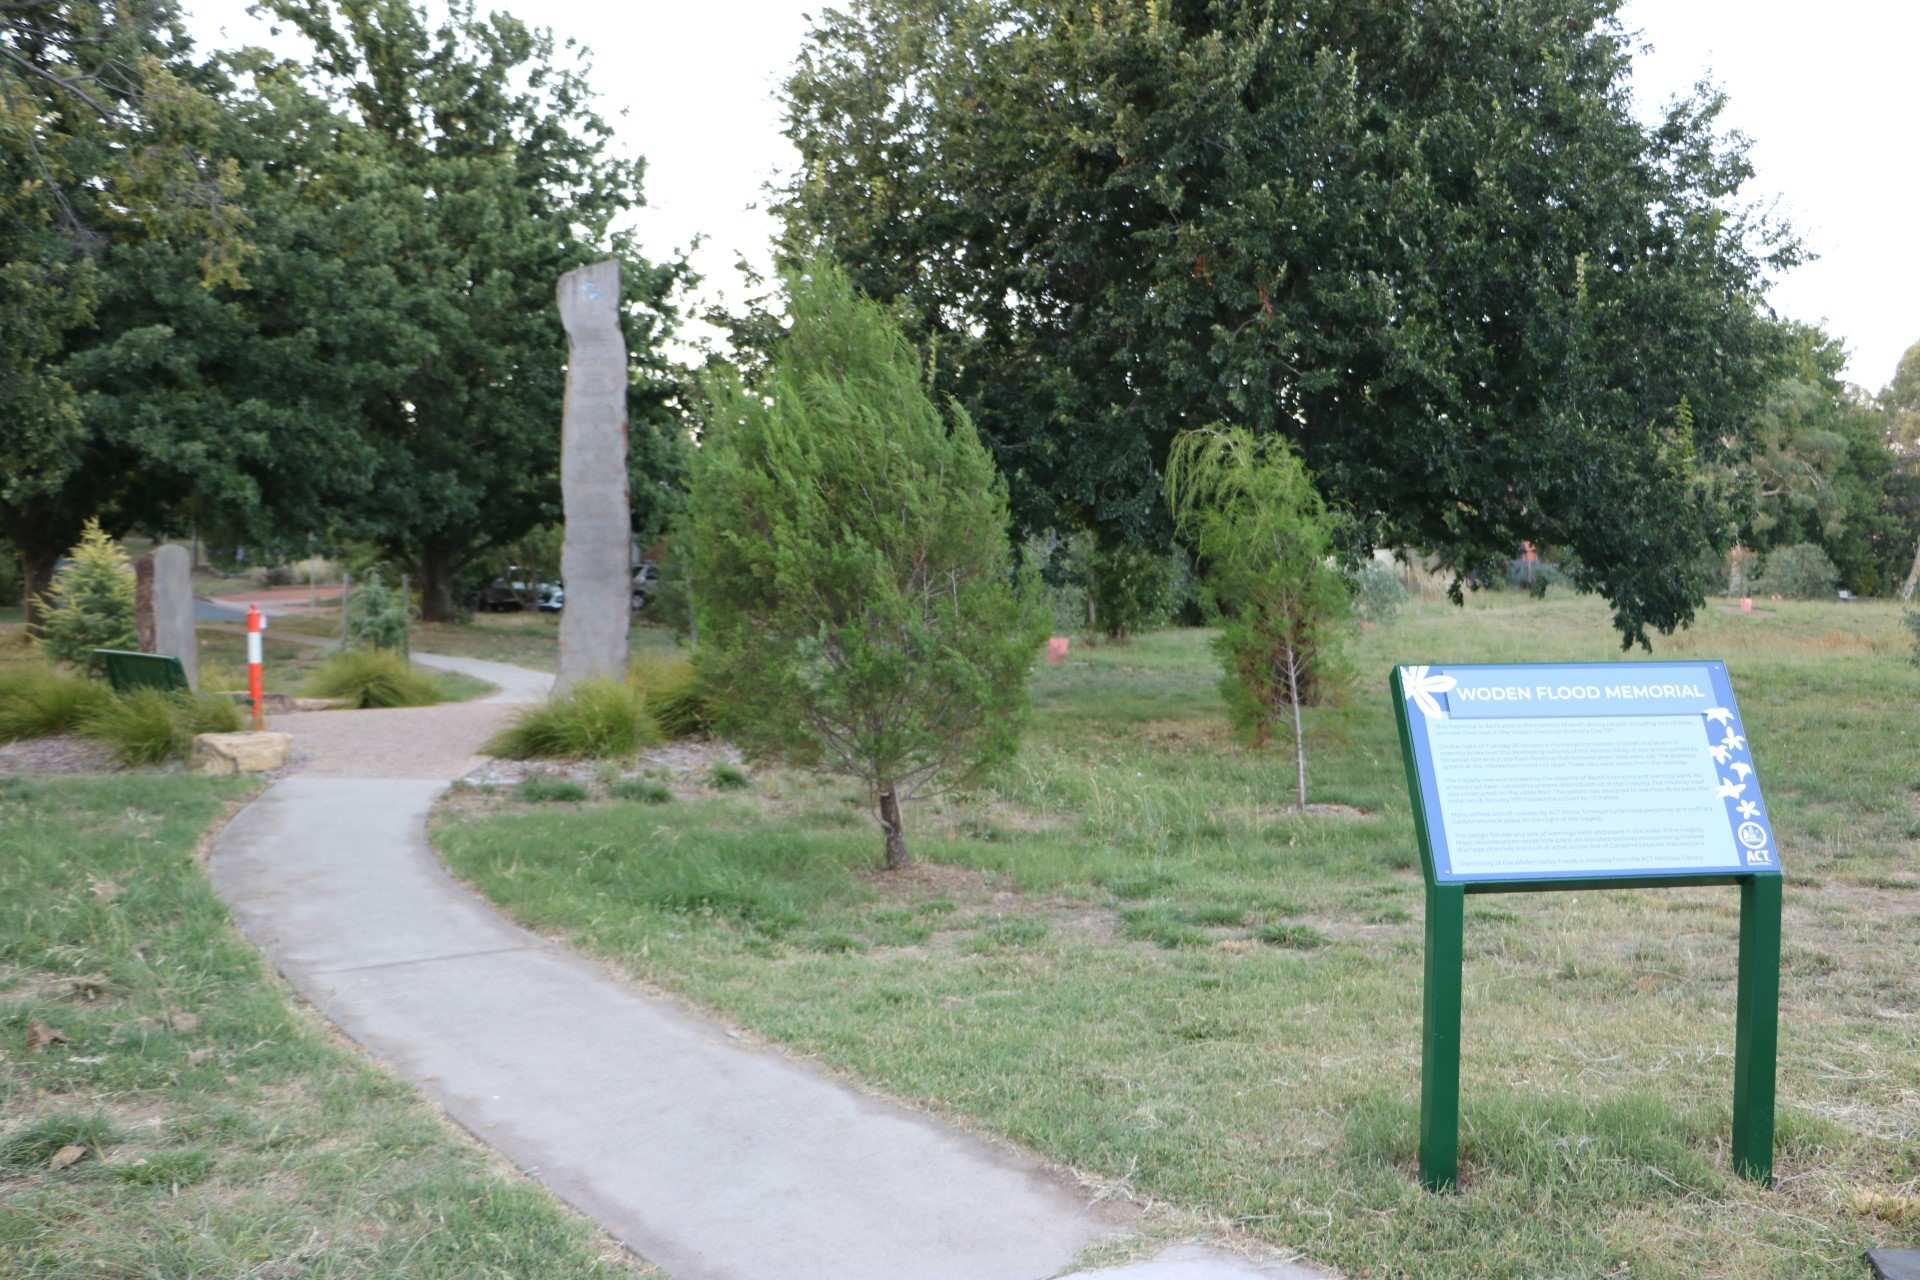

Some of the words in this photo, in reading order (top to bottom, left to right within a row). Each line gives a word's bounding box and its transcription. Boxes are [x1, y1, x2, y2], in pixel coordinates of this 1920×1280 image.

[1456, 687, 1532, 701] WODEN
[1536, 686, 1600, 700] FLOOD
[1605, 684, 1705, 699] MEMORIAL
[1747, 850, 1770, 862] ACT
